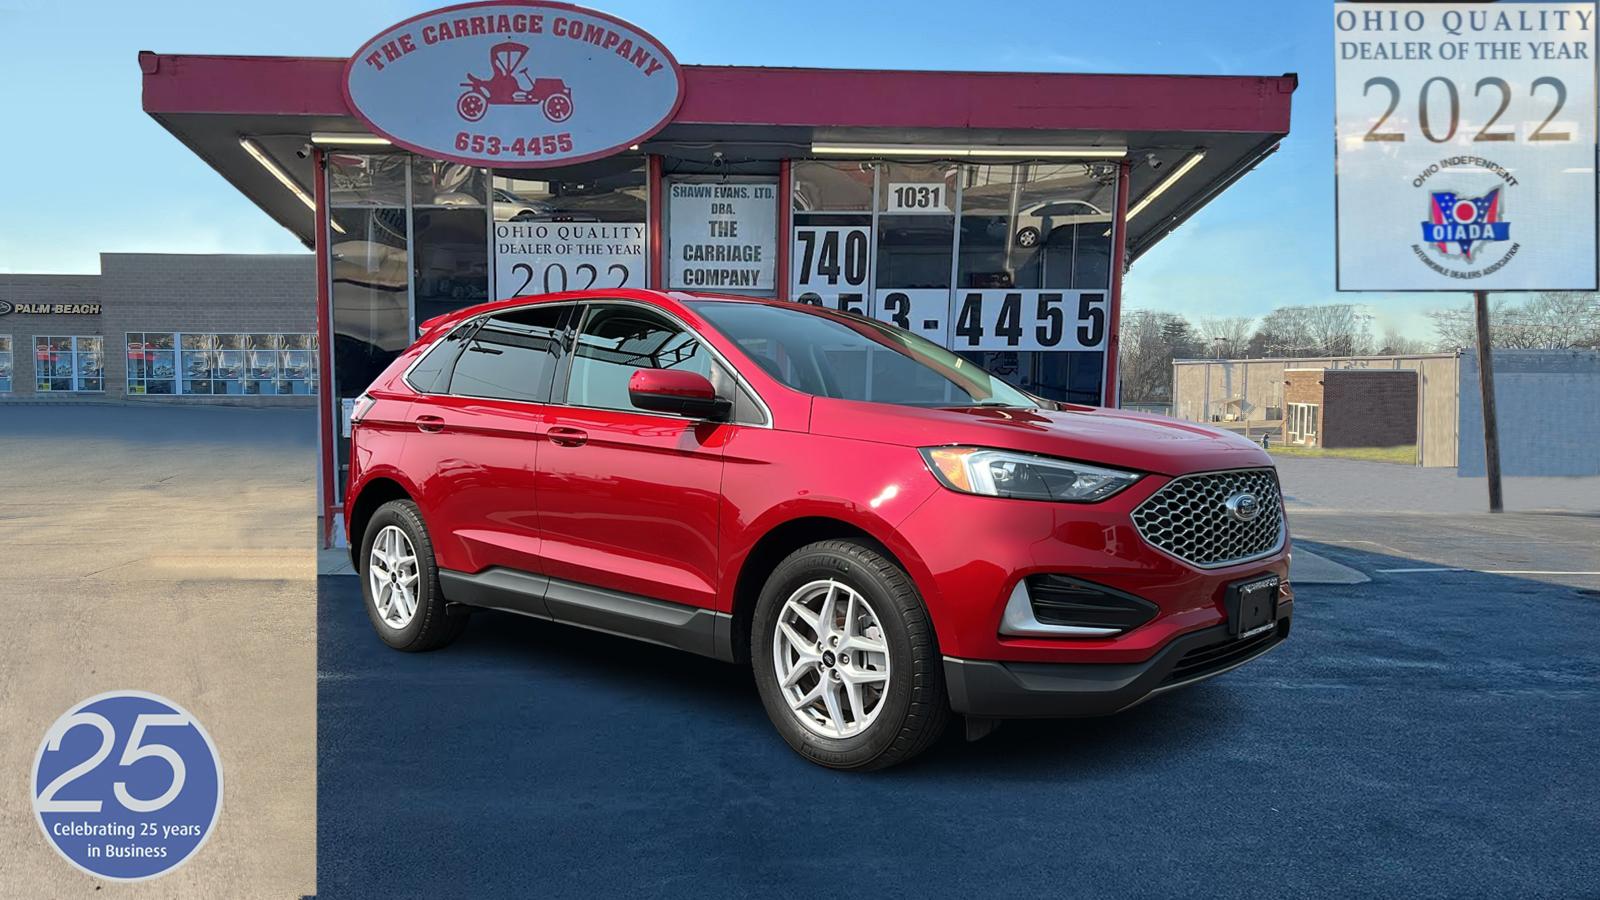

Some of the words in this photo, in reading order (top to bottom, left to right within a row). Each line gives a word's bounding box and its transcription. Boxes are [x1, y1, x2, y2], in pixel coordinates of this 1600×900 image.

[1336, 10, 1425, 32] OHIO
[1442, 10, 1593, 36] QUALITY
[366, 34, 416, 72] THE
[421, 14, 544, 46] CARRIAGE
[552, 17, 664, 77] COMPANY
[1340, 41, 1433, 60] DEALER
[1439, 41, 1469, 60] OF
[1475, 41, 1522, 60] THE
[1528, 41, 1589, 60] YEAR
[1362, 76, 1571, 143] 2022
[454, 132, 573, 156] 653-4455
[1412, 164, 1440, 188] OHIO
[1440, 155, 1519, 187] INDEPENDENT
[672, 186, 712, 199] SHAWN
[754, 187, 774, 199] LTD.
[894, 186, 940, 208] 1031
[711, 203, 735, 215] DBA.
[497, 226, 548, 239] OHIO
[558, 226, 644, 241] QUALITY
[708, 220, 738, 238] THE
[1433, 224, 1495, 240] OIADA
[500, 243, 552, 255] DEALER
[555, 243, 573, 255] OF
[576, 243, 603, 255] THE
[606, 244, 641, 255] YEAR
[683, 244, 762, 262] CARRIAGE
[797, 230, 868, 286] 740
[1411, 244, 1449, 277] AUTOMOBILE
[1450, 269, 1482, 280] DEALERS
[1483, 242, 1521, 276] ASSOCIATION
[511, 263, 630, 298] 2022
[683, 268, 760, 286] COMPANY
[14, 303, 51, 314] PALM
[54, 303, 100, 314] BEACH
